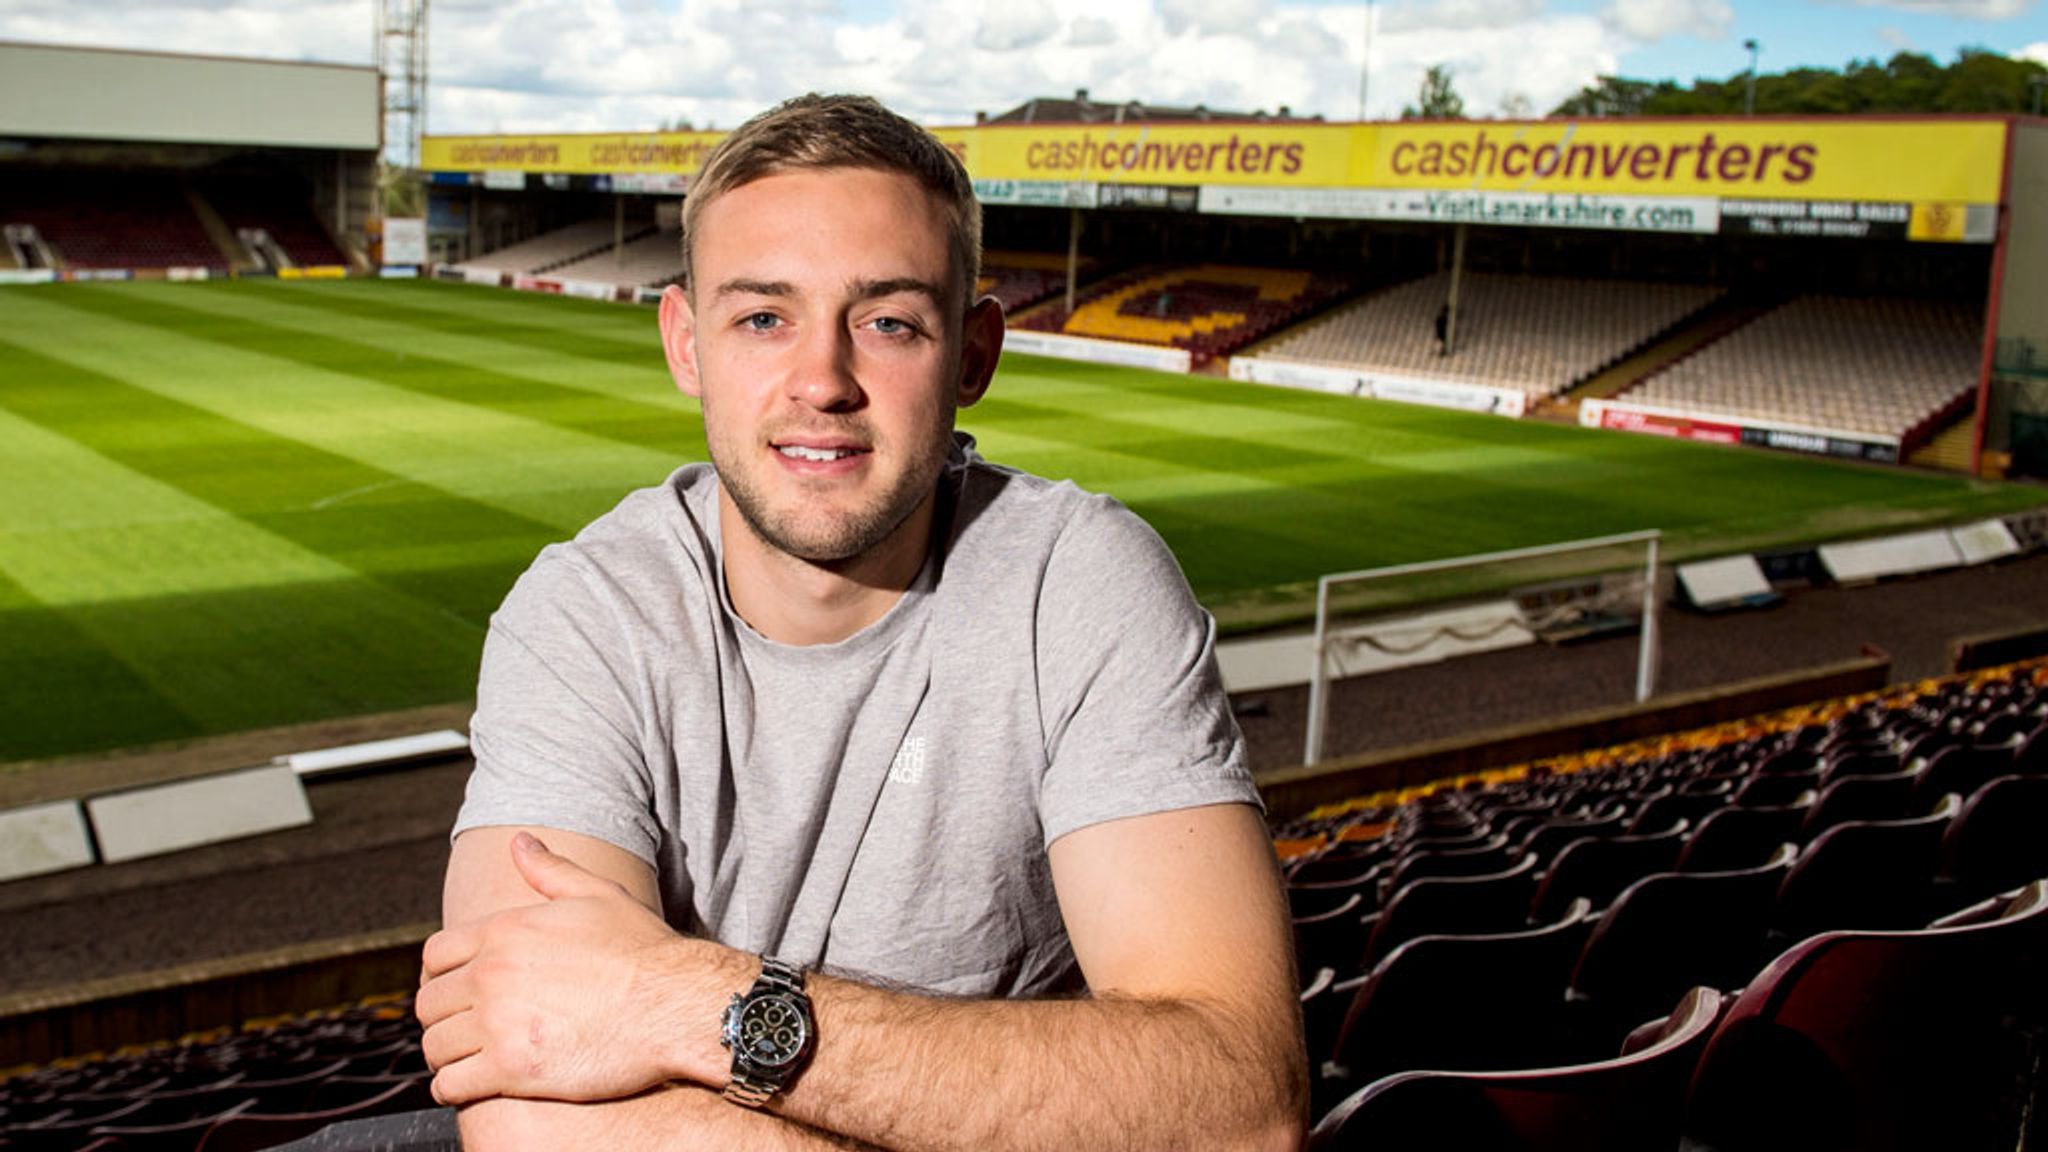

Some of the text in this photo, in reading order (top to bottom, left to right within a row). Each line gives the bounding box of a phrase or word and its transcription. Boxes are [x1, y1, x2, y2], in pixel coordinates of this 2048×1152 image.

[1026, 133, 1305, 175] cashconverters
[1391, 131, 1819, 183] cashconverters
[1427, 192, 1695, 226] VisitLanarkshire.com
[903, 736, 926, 752] HE
[888, 768, 923, 784] ACE
